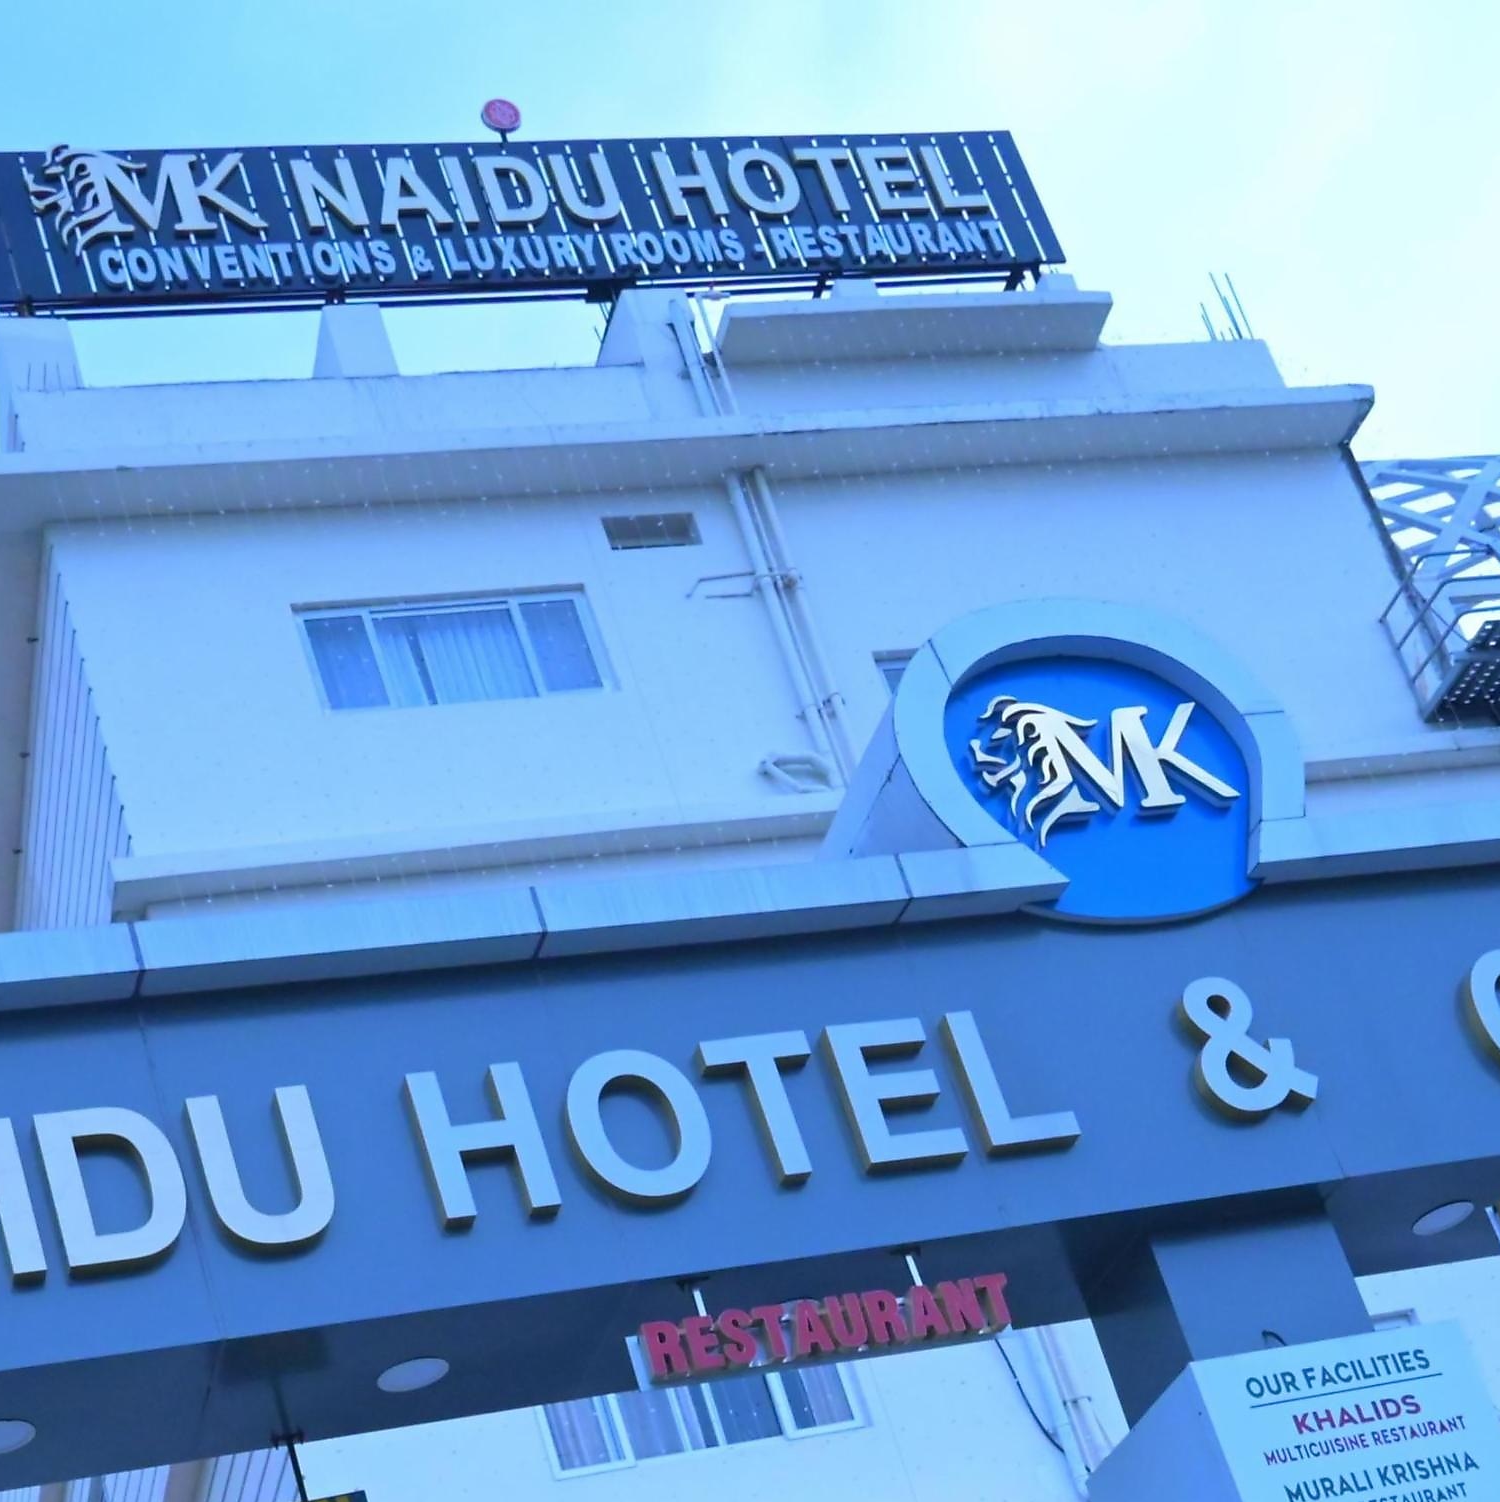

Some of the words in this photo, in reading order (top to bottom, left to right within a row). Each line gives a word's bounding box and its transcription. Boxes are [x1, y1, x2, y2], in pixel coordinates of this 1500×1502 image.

[289, 152, 622, 231] NAIDU
[651, 146, 990, 221] HOTEL
[99, 240, 396, 288] CONVENTIONS
[411, 246, 434, 273] &
[444, 232, 599, 273] LUXURY
[610, 230, 746, 266] ROOMS
[774, 220, 1004, 261] RESTAURANT
[1000, 698, 1240, 835] MK
[403, 1011, 1080, 1230] HOTEL
[1178, 977, 1319, 1122] &
[640, 1273, 1011, 1378] RESTAURANT
[1245, 1371, 1300, 1399] OUR
[1302, 1349, 1431, 1389] FACILITIES
[1264, 1433, 1370, 1466] MULTICUISINE
[1371, 1415, 1466, 1446] RESTAURANT
[1292, 1394, 1422, 1435] KHALIDS
[1376, 1451, 1479, 1487] KRISHNA
